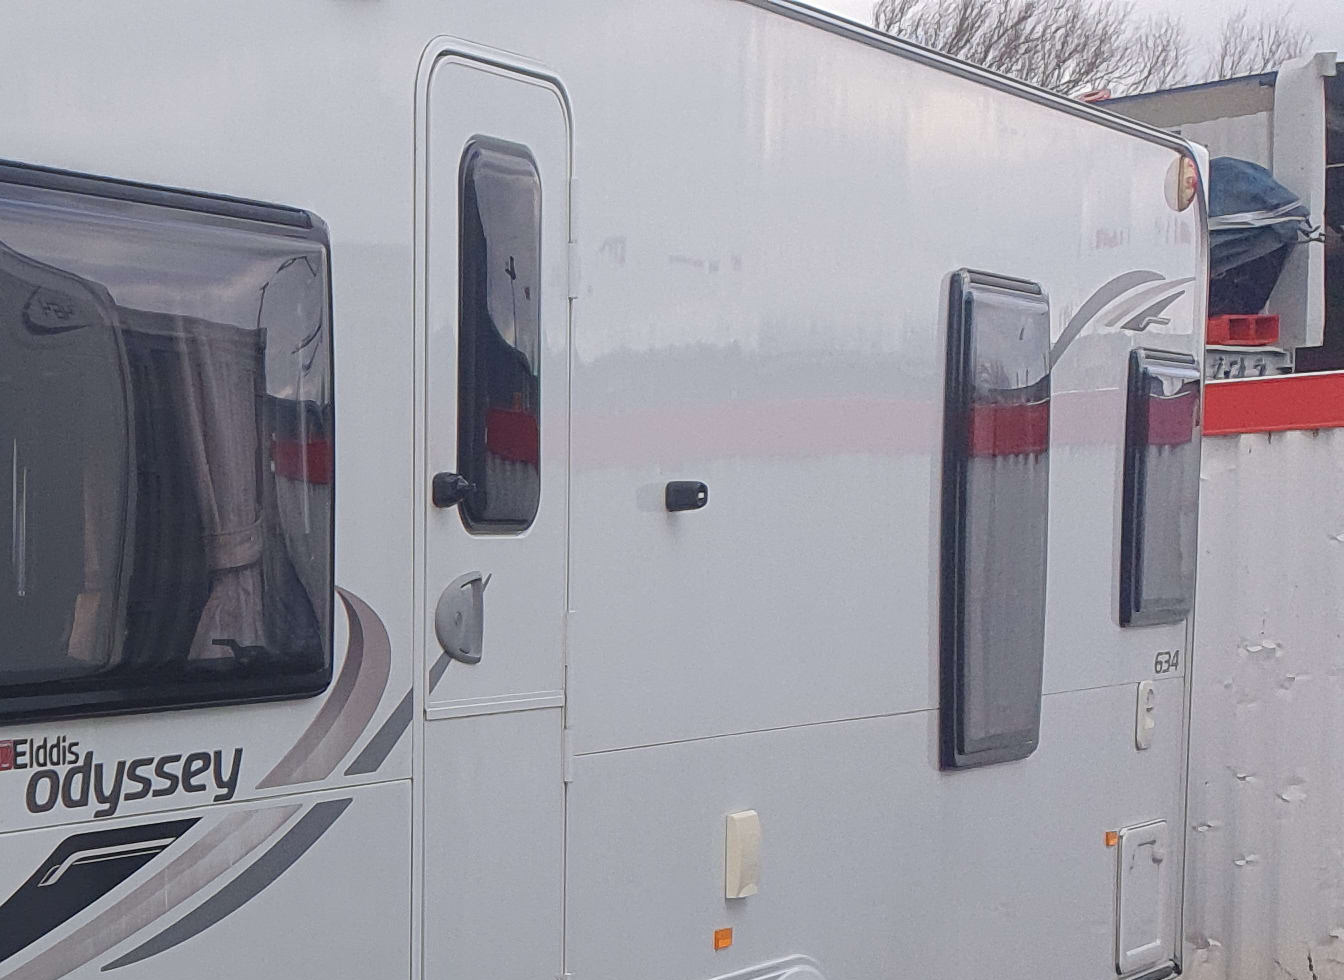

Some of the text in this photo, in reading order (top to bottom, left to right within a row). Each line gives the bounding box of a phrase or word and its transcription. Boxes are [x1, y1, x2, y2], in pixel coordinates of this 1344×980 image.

[1155, 650, 1179, 673] 634
[13, 735, 79, 769] Elddis
[26, 748, 243, 818] odyssey
